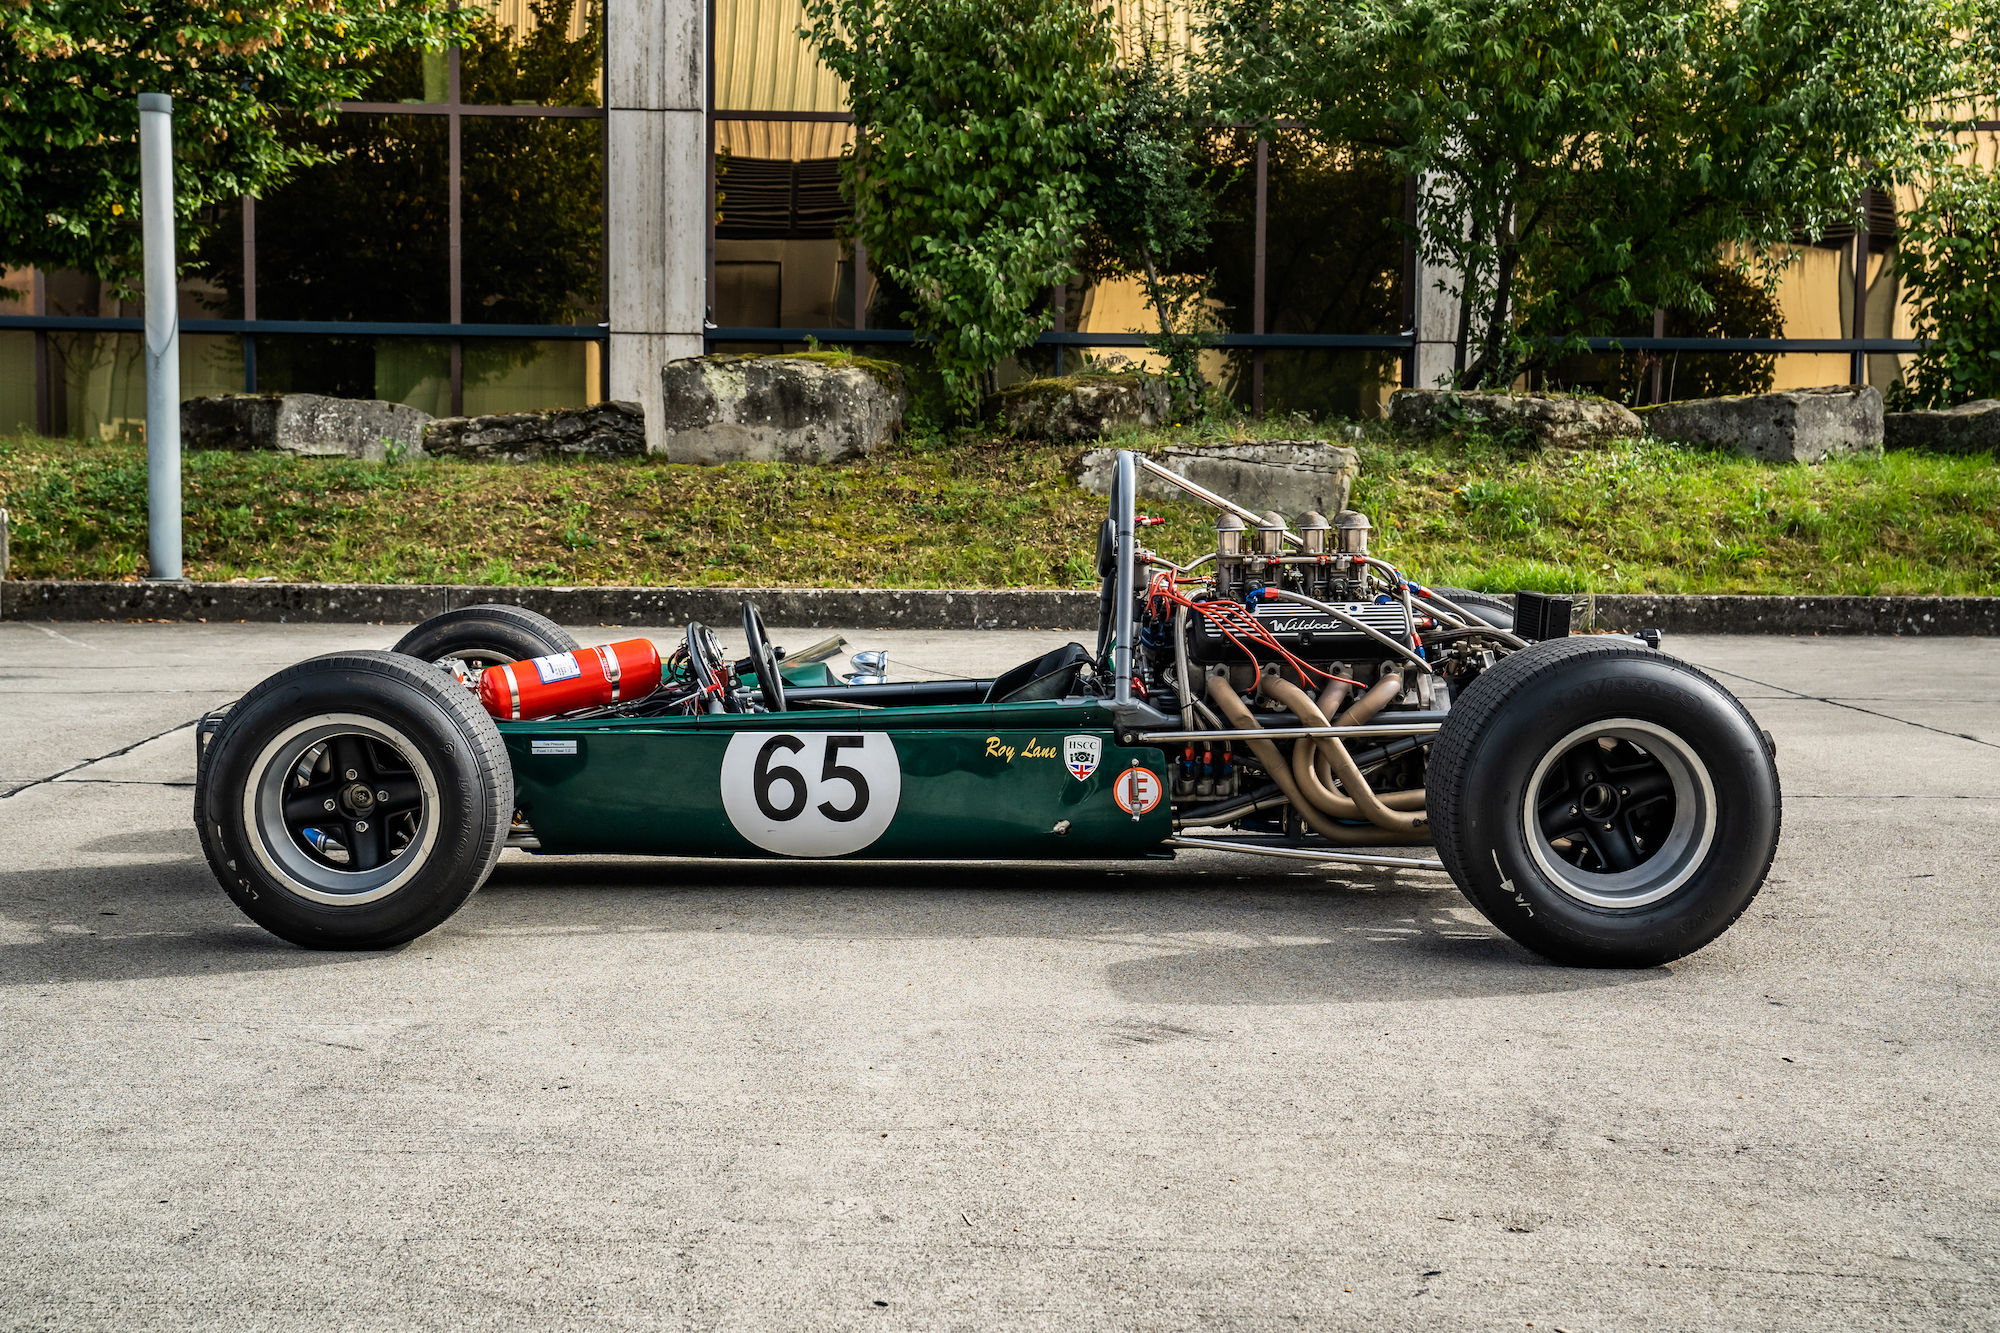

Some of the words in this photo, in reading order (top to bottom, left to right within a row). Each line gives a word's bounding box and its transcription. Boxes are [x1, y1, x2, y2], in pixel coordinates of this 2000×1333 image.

[1269, 617, 1343, 632] Wildcat
[985, 736, 1016, 763] Roy
[1020, 737, 1058, 759] Lane
[1069, 741, 1097, 750] HSCC
[753, 734, 870, 822] 65
[1128, 778, 1149, 804] E
